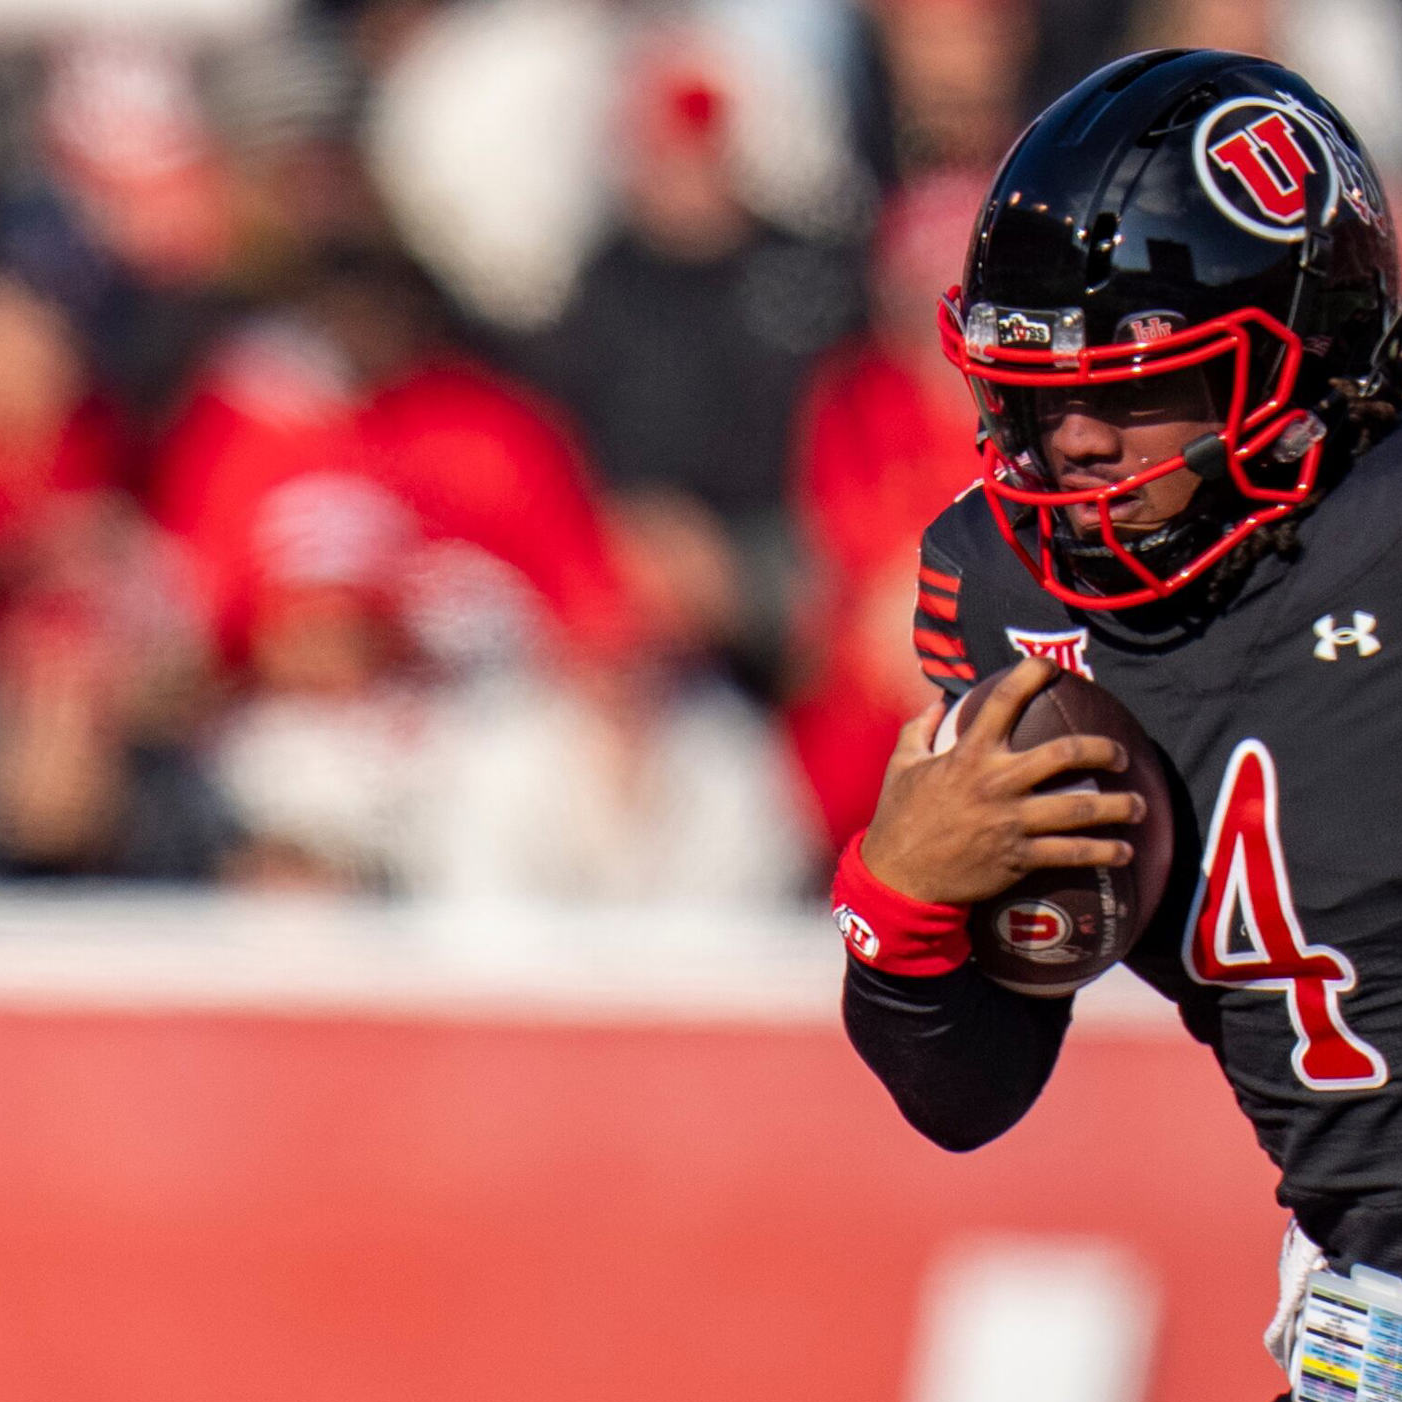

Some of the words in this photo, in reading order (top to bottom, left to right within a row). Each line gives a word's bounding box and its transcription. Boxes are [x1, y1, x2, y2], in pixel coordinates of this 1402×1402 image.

[1207, 110, 1317, 226] U
[1008, 909, 1058, 943] U
[1181, 736, 1389, 1092] 4
